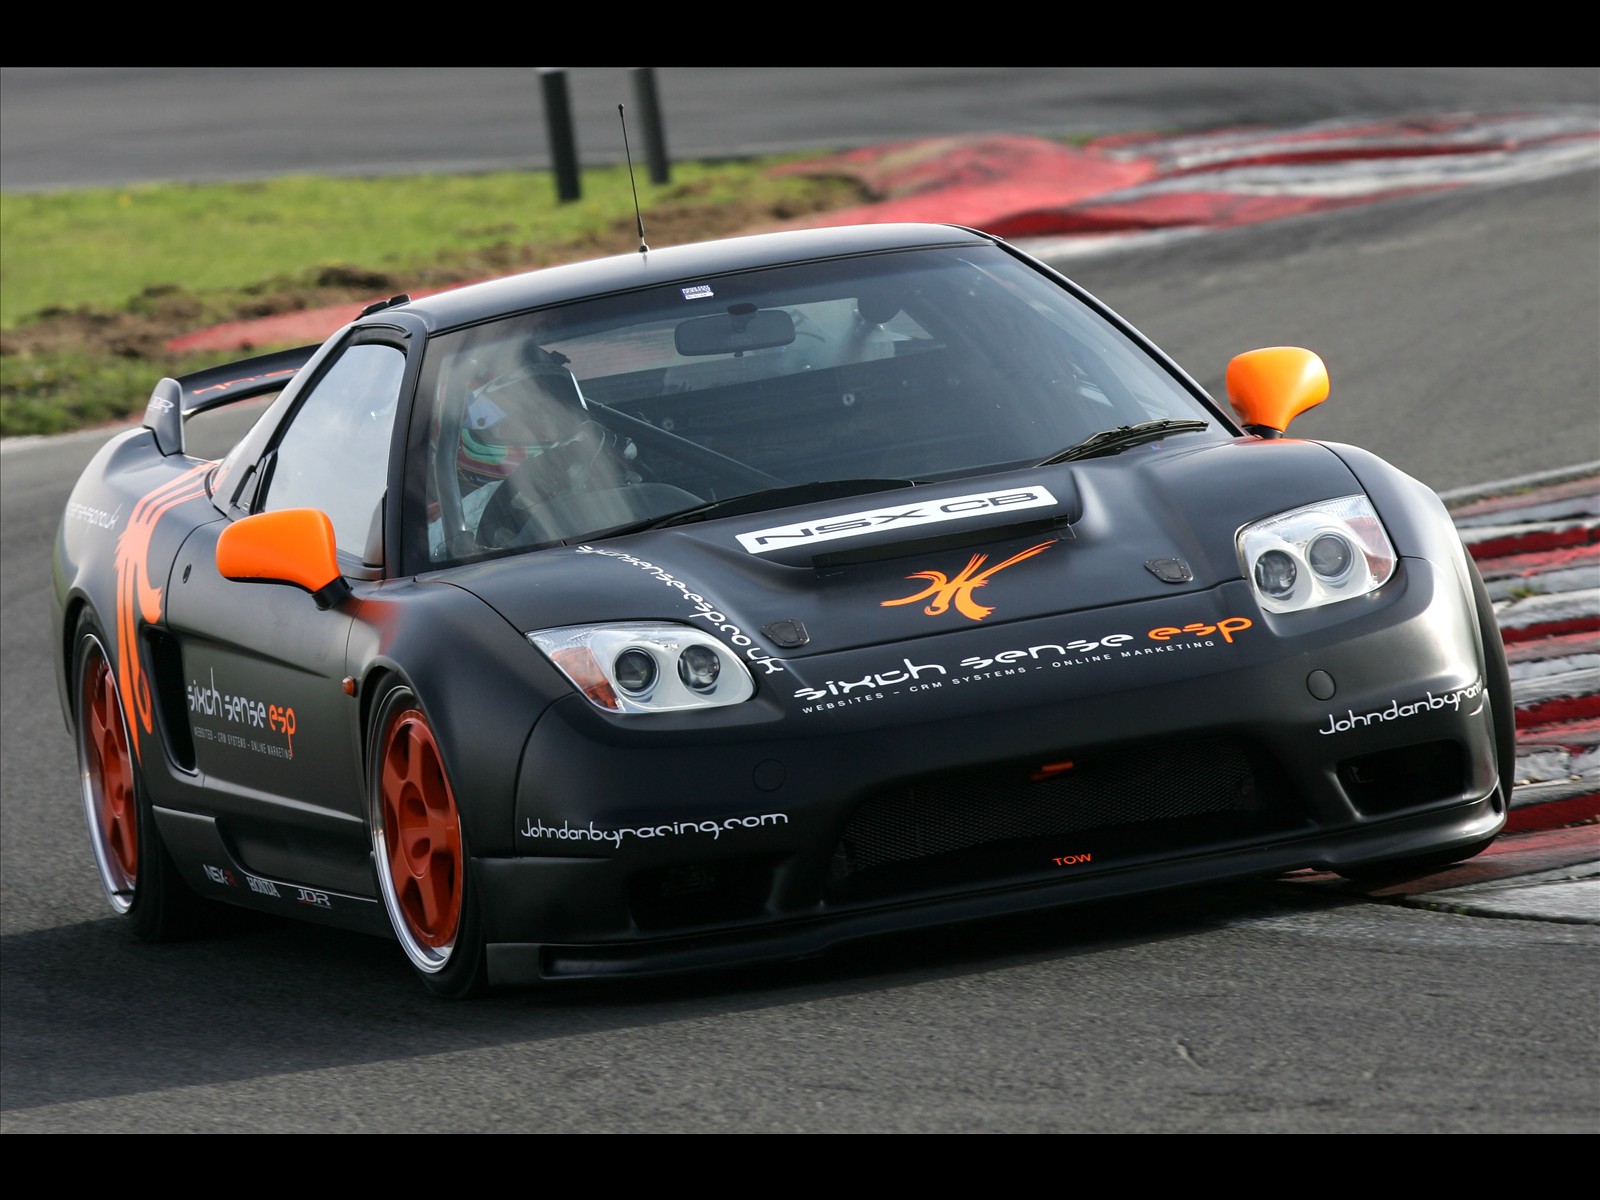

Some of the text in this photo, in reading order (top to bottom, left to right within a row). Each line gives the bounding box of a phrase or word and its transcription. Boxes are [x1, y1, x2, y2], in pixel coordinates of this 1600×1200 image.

[754, 491, 1039, 546] NSX CB
[960, 633, 1134, 669] sense
[1147, 616, 1253, 644] esp
[802, 640, 1215, 714] WEBSITES CRM SYSTEMS ONLINE MARKETING
[224, 694, 267, 729] sense
[268, 704, 297, 759] esp
[520, 812, 789, 849] Johndanbyracing.com
[1052, 852, 1092, 867] TOW
[246, 876, 282, 898] HONDA
[296, 888, 332, 906] JDR
